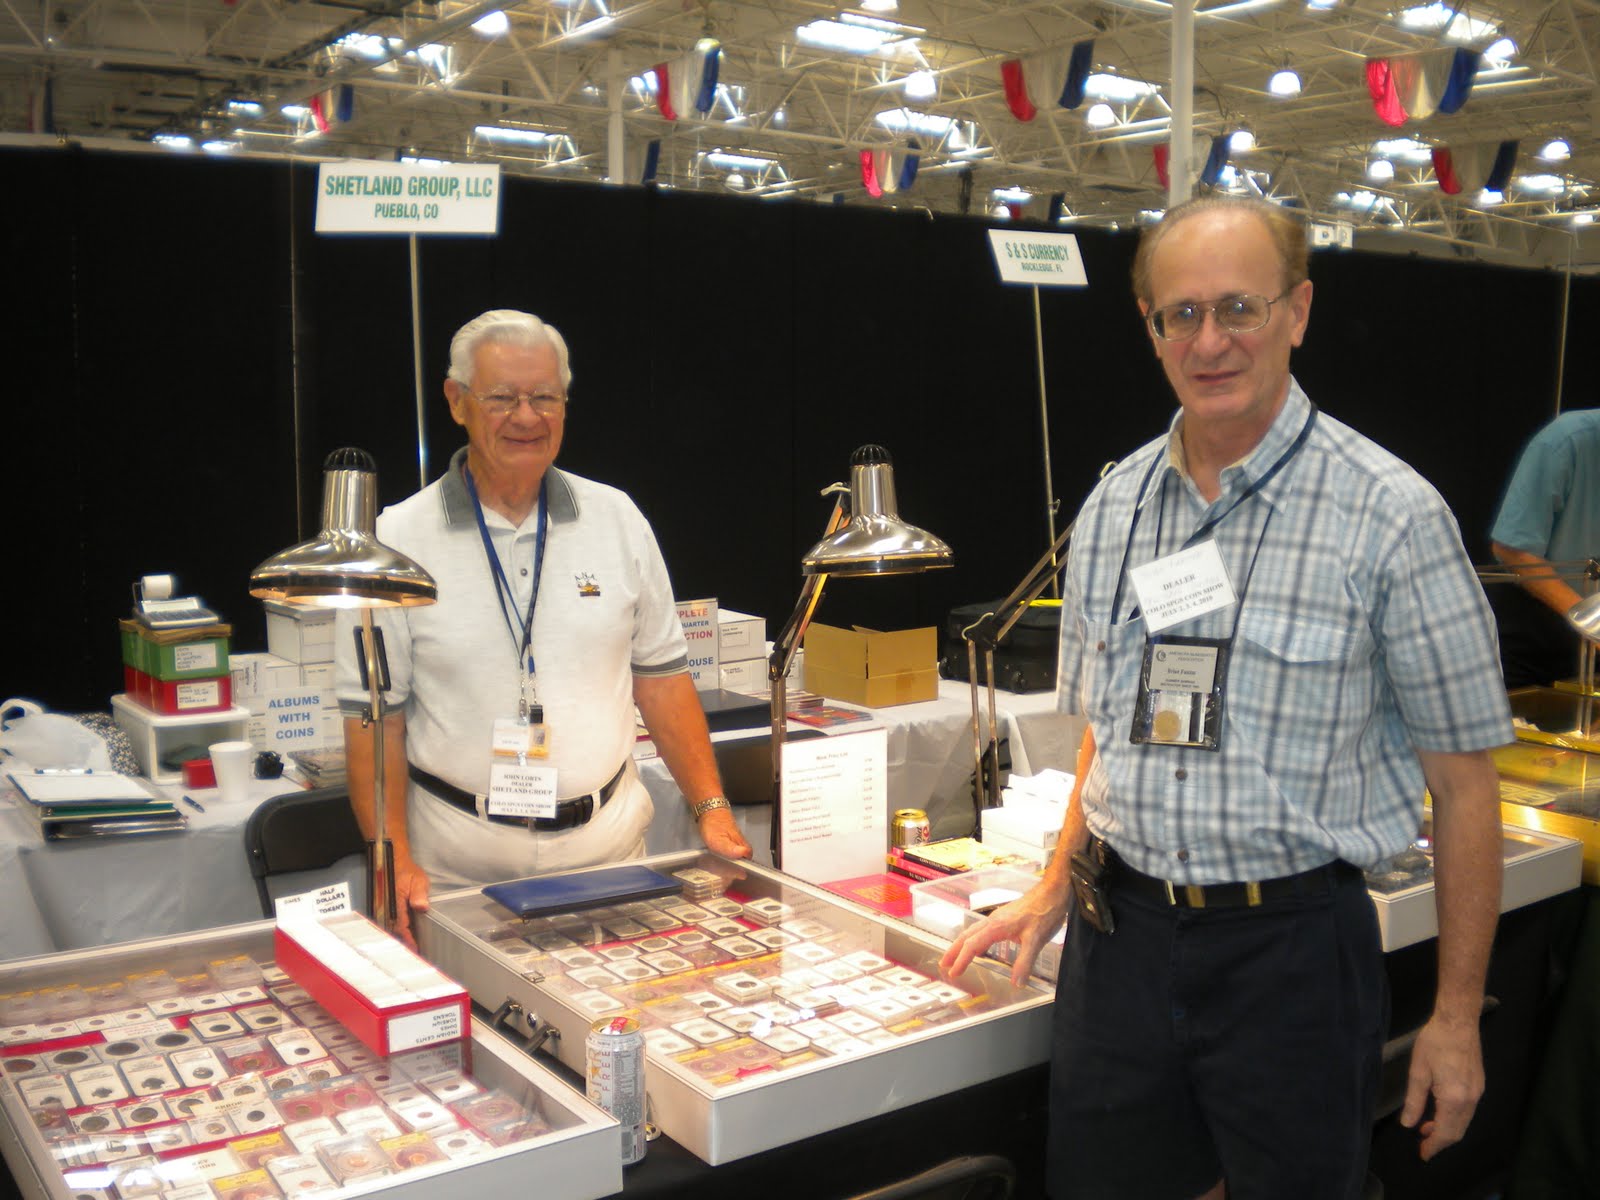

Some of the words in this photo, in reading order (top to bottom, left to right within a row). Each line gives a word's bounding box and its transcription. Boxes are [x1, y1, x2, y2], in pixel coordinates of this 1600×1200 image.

[325, 175, 403, 196] SHETLAND
[408, 176, 461, 200] GROUP,
[465, 177, 492, 197] LLC
[374, 203, 420, 220] PUEBLO,
[424, 203, 439, 219] CO
[1006, 243, 1013, 258] S
[1013, 243, 1021, 258] &
[1021, 243, 1028, 259] S
[1028, 244, 1069, 260] CURRENCY
[1056, 263, 1063, 273] FL
[1163, 573, 1196, 591] DEALER
[1184, 590, 1202, 602] COIN
[1203, 582, 1225, 597] SHOW
[676, 608, 708, 618] PLETE
[1161, 607, 1178, 618] JULY
[268, 695, 320, 709] ALBUMS
[278, 712, 311, 724] WITH
[276, 727, 315, 740] COINS
[492, 785, 528, 794] SHETLAND
[529, 788, 553, 796] GROUP
[320, 888, 335, 897] HALF
[316, 892, 345, 905] DOLLARS
[319, 903, 345, 914] TOKENS
[433, 1012, 456, 1020] TOKENS
[415, 1034, 436, 1044] CENTS
[437, 1030, 458, 1039] INDIAN
